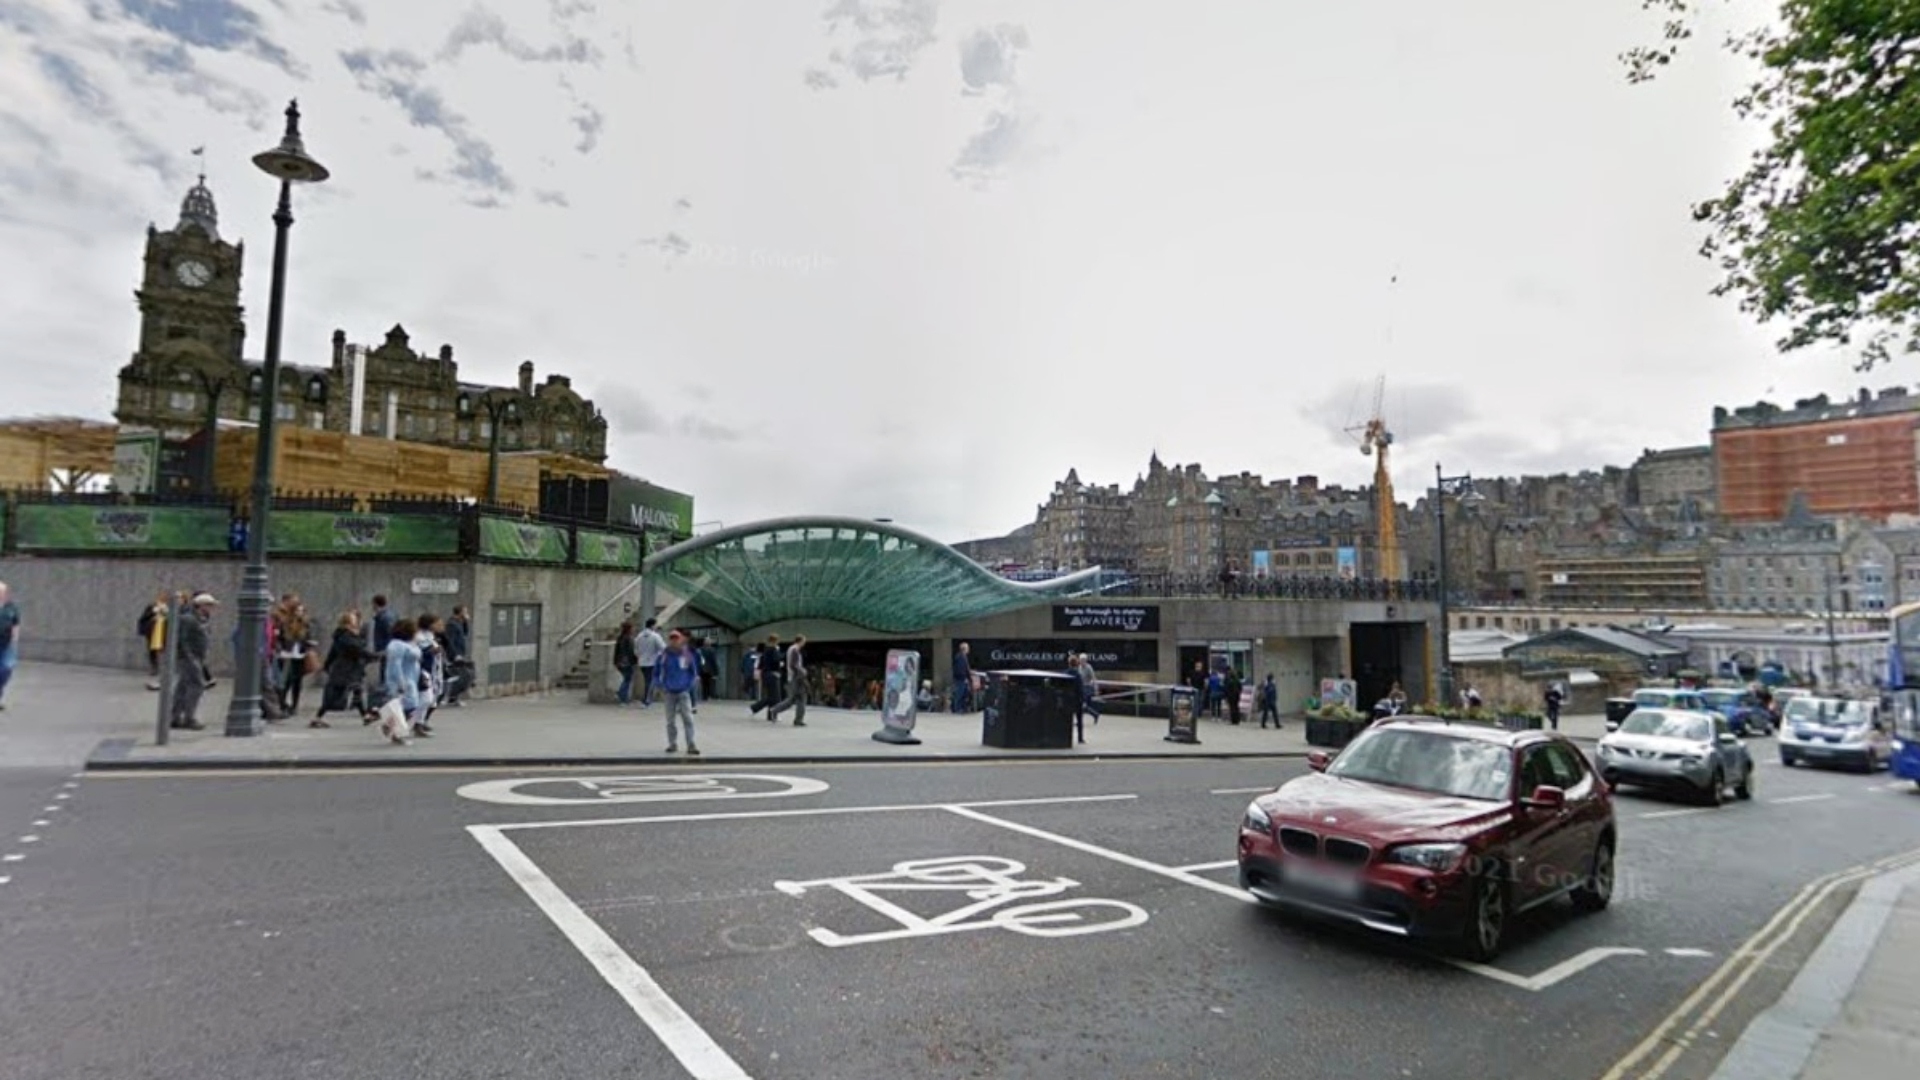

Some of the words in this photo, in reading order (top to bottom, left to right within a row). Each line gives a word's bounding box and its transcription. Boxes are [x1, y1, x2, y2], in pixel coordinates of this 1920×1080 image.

[1064, 606, 1084, 615] Route
[1085, 606, 1112, 617] through
[1113, 607, 1121, 615] to
[1082, 616, 1143, 627] WAVERLEY
[990, 649, 1053, 661] GLENEAGLES
[1053, 652, 1066, 660] OF
[1067, 649, 1118, 662] STLAND
